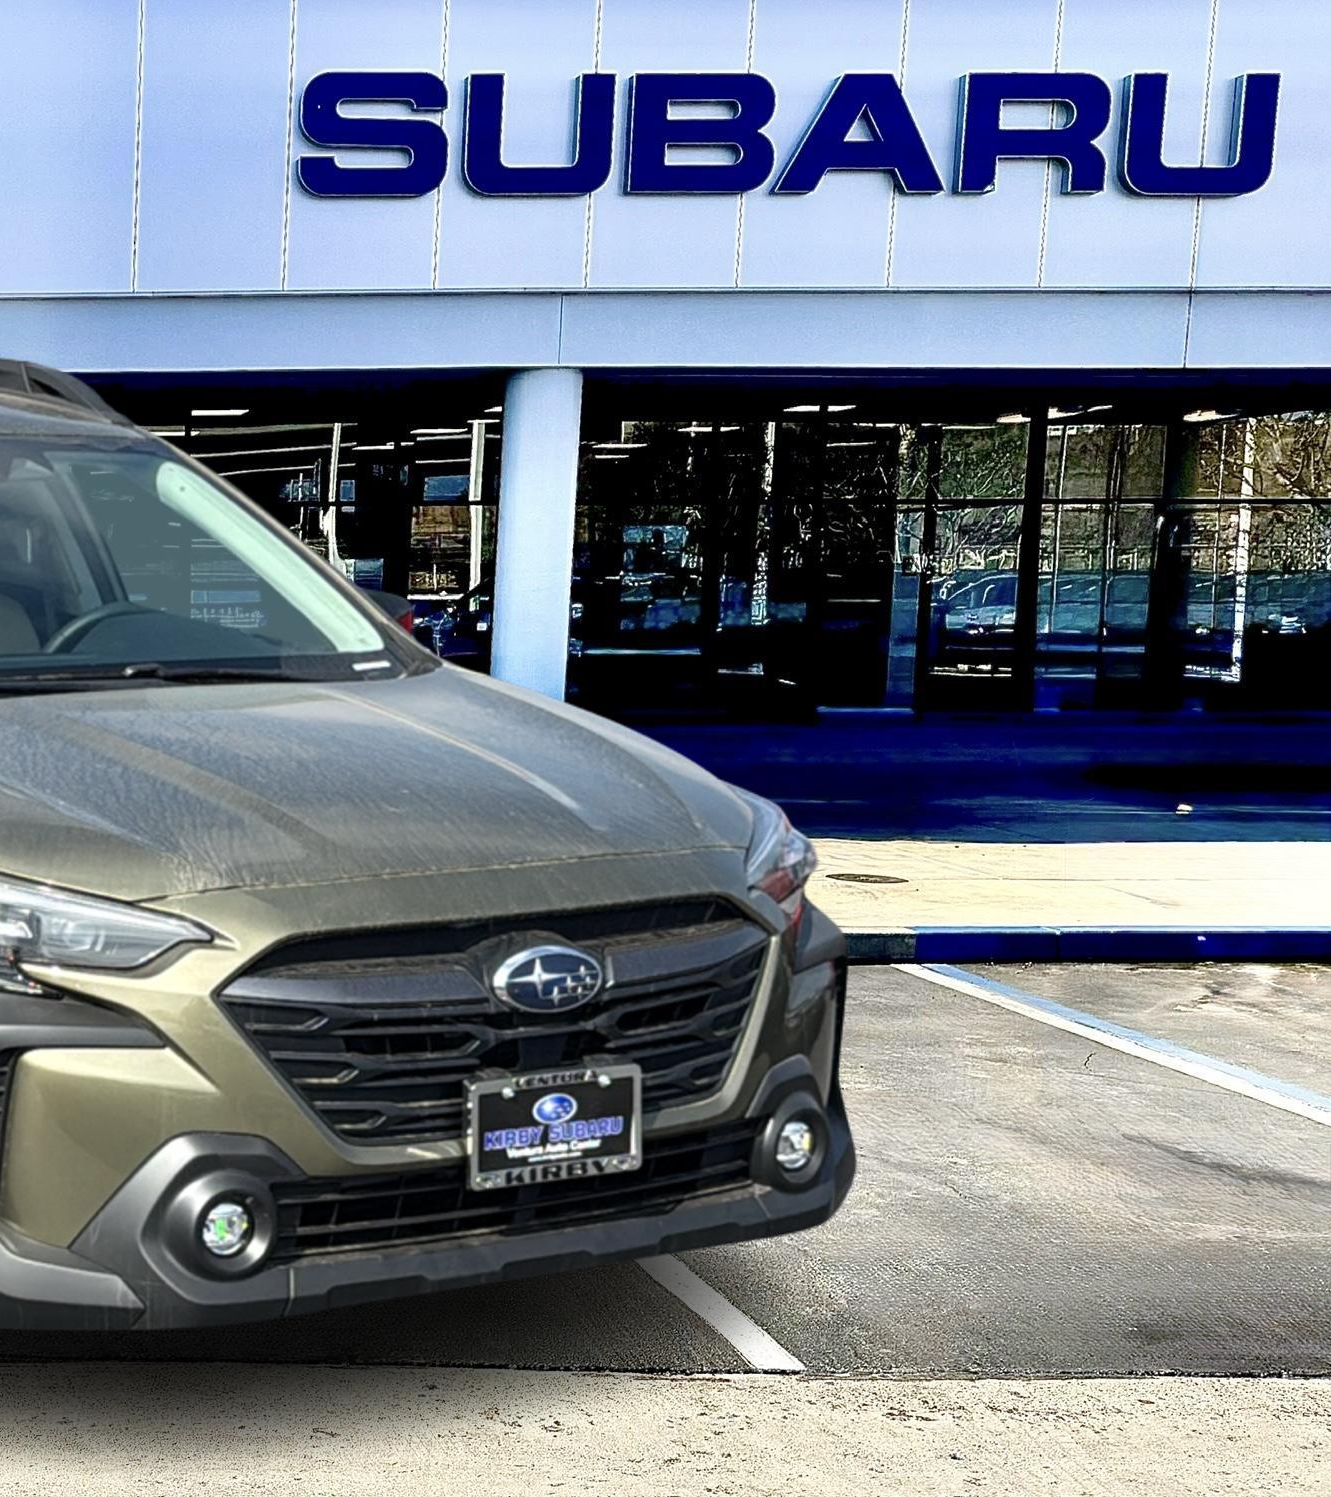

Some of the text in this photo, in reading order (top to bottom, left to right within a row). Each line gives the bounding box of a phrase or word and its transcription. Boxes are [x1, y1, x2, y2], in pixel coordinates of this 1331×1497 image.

[297, 71, 1281, 199] SUBARU
[483, 1116, 623, 1151] KIRBY SUBARU
[505, 1159, 608, 1185] KIRBY
